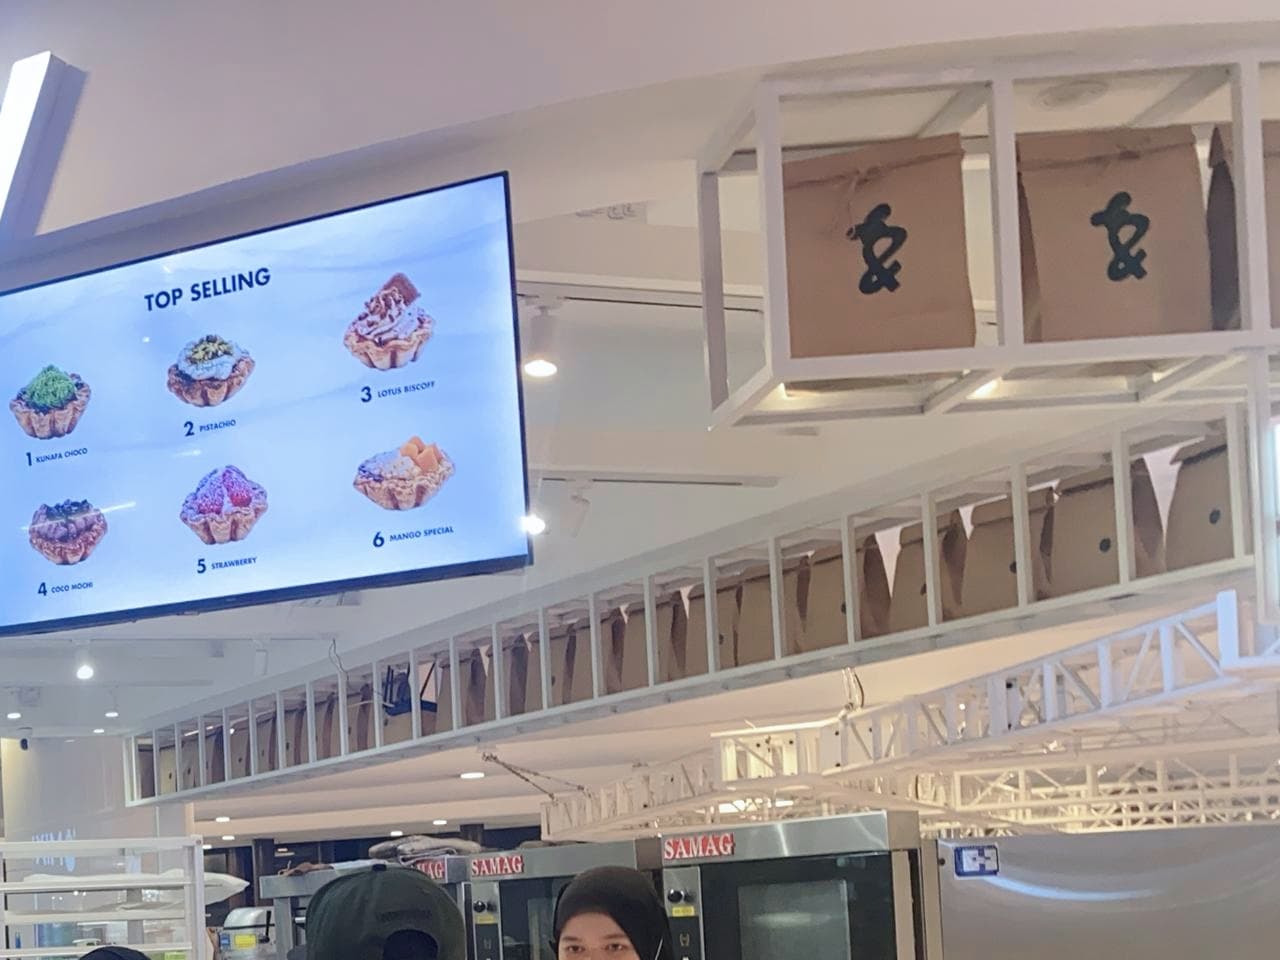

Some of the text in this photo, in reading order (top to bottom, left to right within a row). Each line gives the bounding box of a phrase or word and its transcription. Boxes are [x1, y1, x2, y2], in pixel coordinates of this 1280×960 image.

[144, 267, 271, 312] TOP SELLING
[361, 386, 372, 403] 3
[378, 386, 402, 398] LOTUS
[183, 419, 237, 437] 2 PISTACHIO
[26, 447, 88, 467] 1 KUNAFA CHOCO
[373, 526, 455, 548] 6 MANGO SPECIAL
[197, 556, 258, 574] 5 STRAWBERRY
[38, 582, 48, 596] 4
[51, 585, 70, 593] COCO
[663, 833, 735, 861] SAMAG
[471, 854, 524, 877] SAMAG
